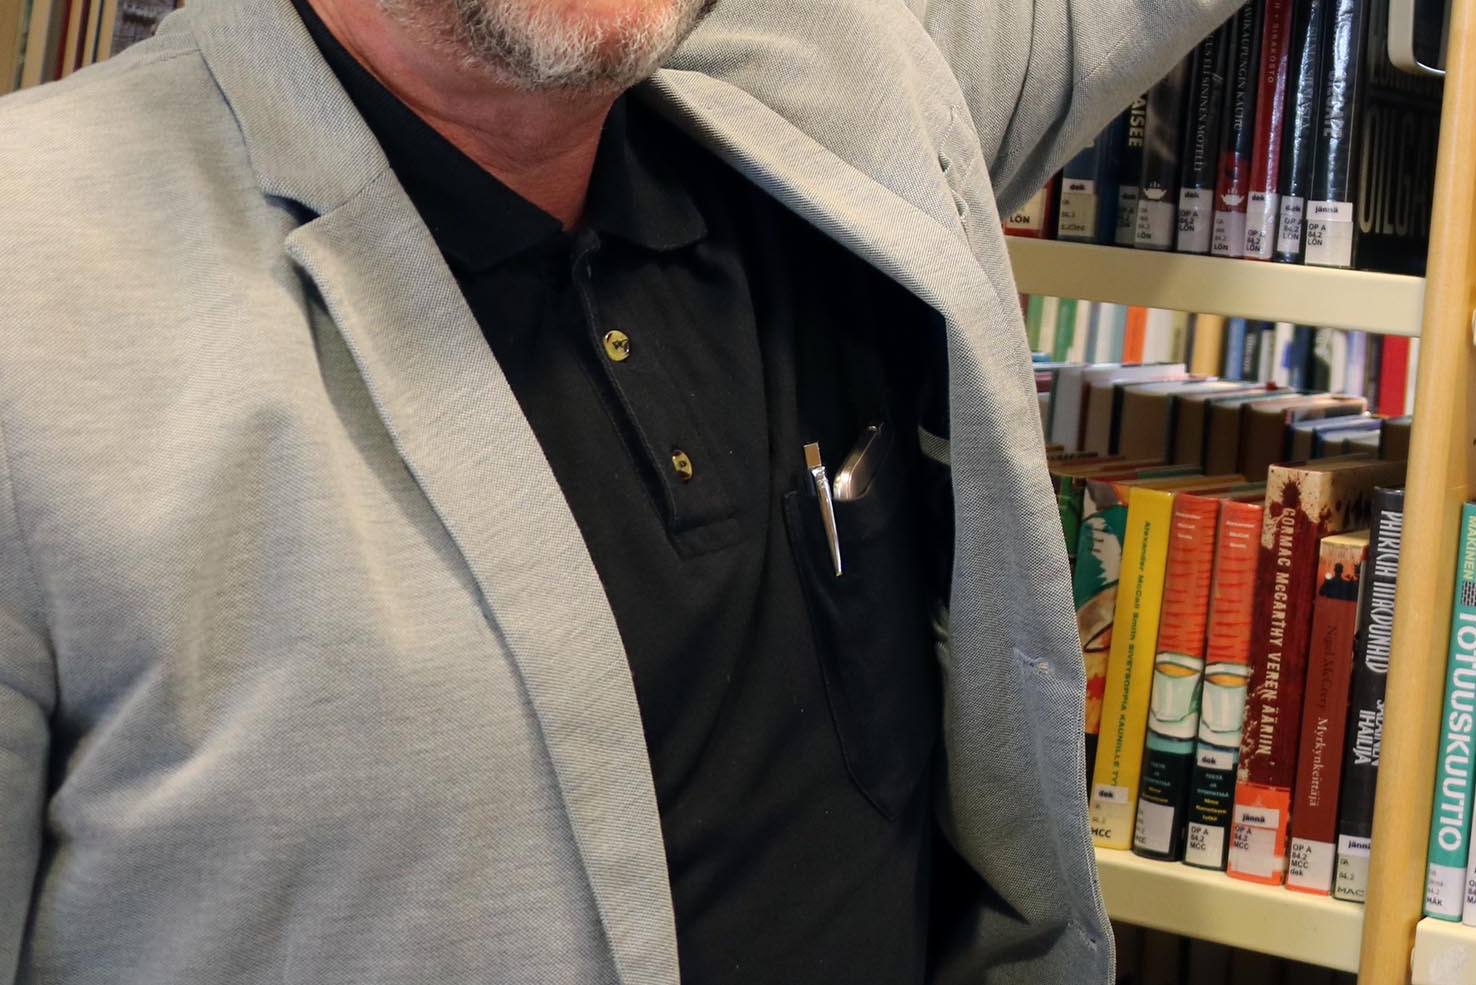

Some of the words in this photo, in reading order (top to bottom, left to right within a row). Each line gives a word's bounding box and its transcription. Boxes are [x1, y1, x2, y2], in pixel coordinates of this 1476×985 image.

[1277, 508, 1296, 567] CORMAC
[1263, 652, 1282, 700] VEREN
[1255, 705, 1279, 755] ÄÄNIIN
